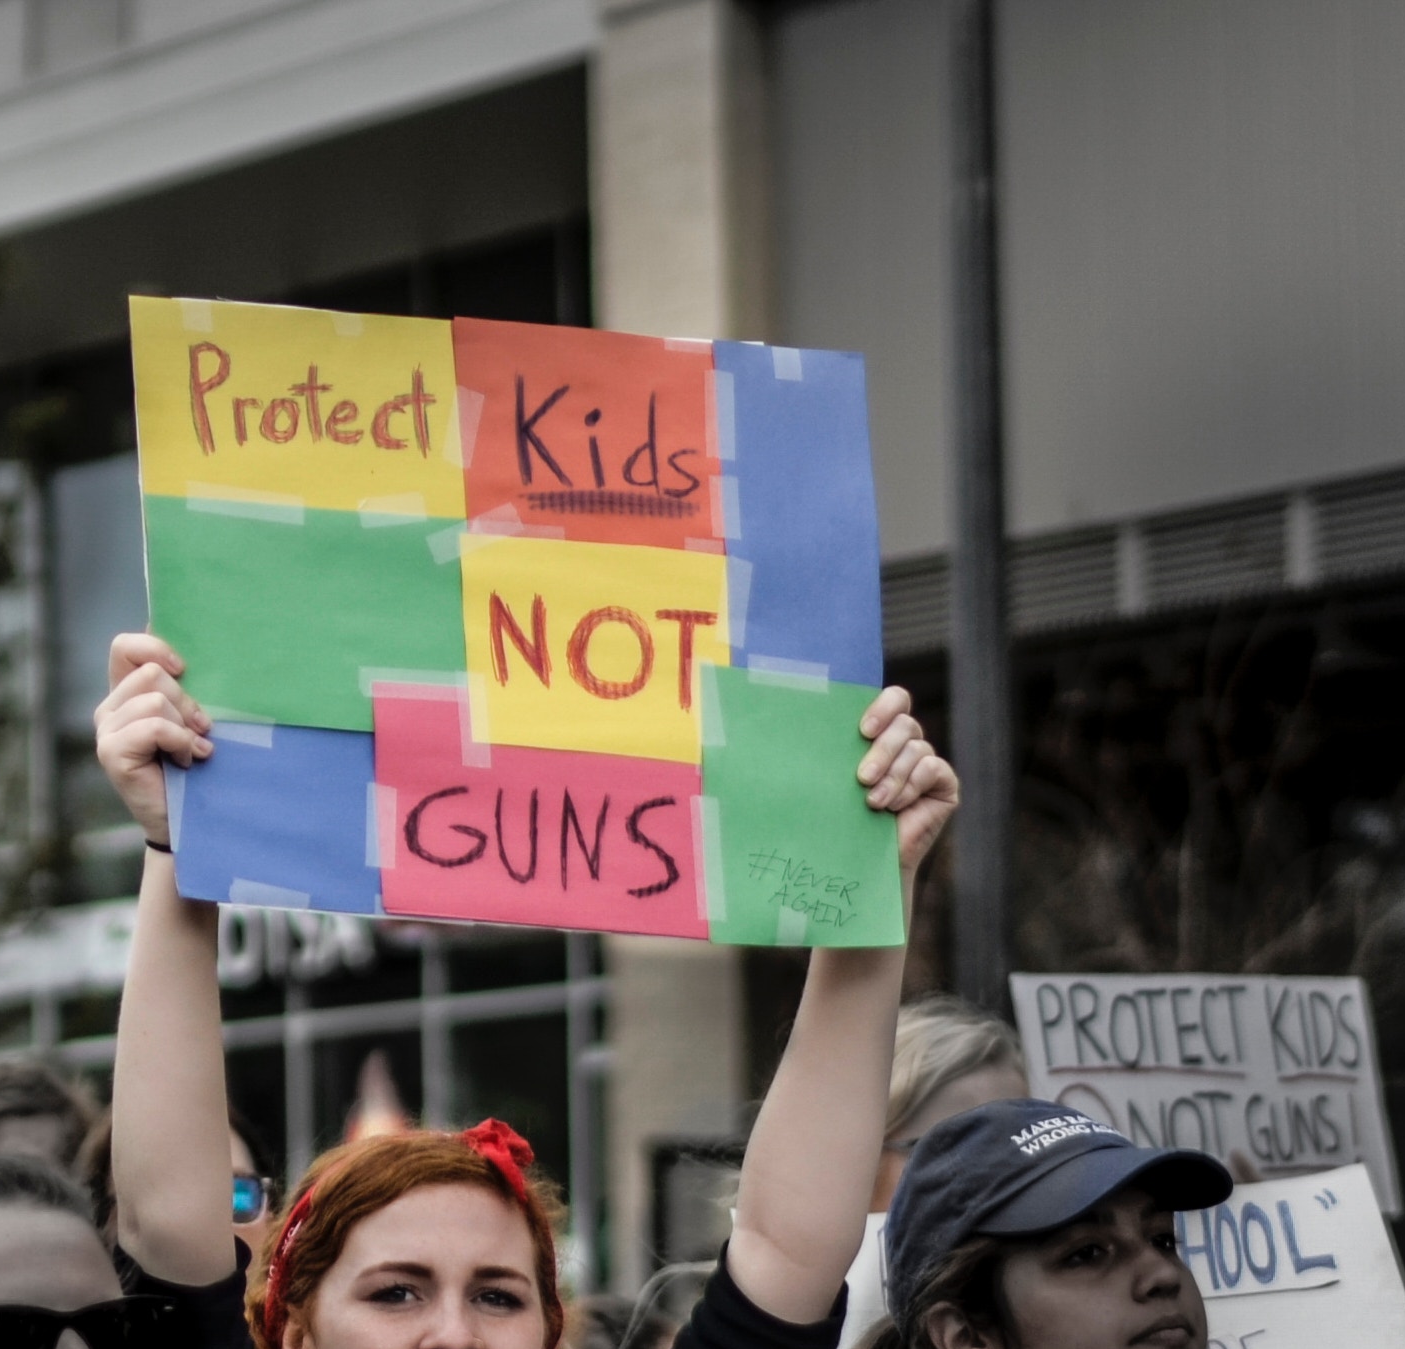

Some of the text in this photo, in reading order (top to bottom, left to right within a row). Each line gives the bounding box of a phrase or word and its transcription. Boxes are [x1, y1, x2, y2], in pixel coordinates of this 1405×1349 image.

[188, 341, 702, 500] Protect Kids
[488, 590, 718, 714] NOT
[403, 786, 681, 899] GUNS
[748, 848, 860, 906] #NEVER
[767, 883, 858, 928] AGAIN
[1036, 981, 1363, 1072] PROTECT KIDS
[1010, 1117, 1067, 1146] MAKE
[1019, 1124, 1092, 1156] WRONG
[1126, 1090, 1233, 1156] NOT
